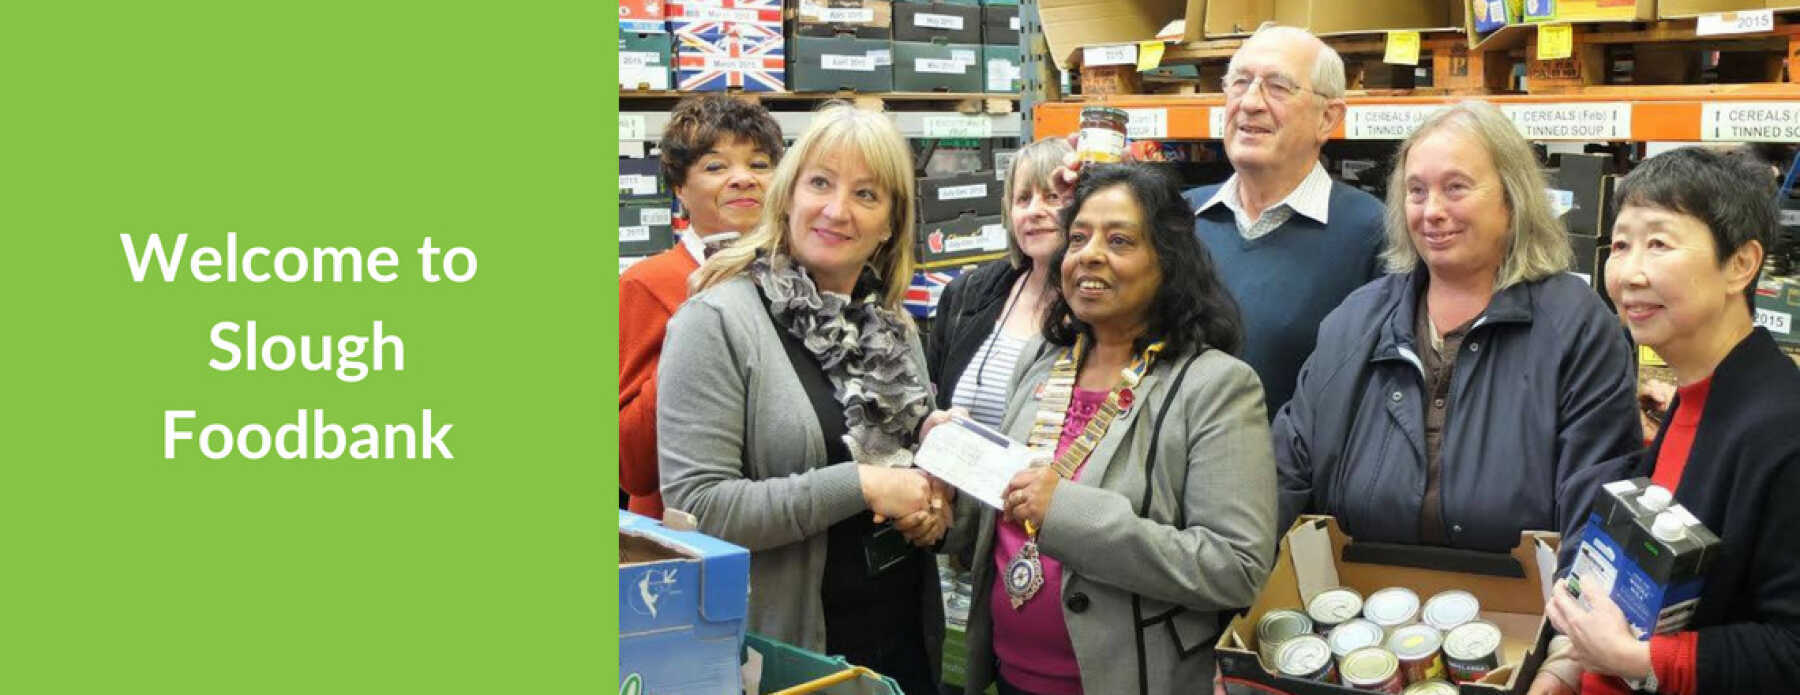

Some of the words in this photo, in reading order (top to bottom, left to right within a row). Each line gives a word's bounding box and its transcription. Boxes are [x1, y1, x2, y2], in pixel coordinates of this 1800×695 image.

[1737, 14, 1769, 29] 2015
[1365, 111, 1410, 122] CEREALS
[1523, 110, 1575, 121] CEREALS
[1578, 110, 1607, 122] (Feb)
[1728, 109, 1790, 121] CEREALS
[1367, 125, 1405, 136] TINNED
[1526, 126, 1568, 136] TINNED
[1571, 126, 1604, 136] SOUP
[1731, 126, 1781, 137] TINNED
